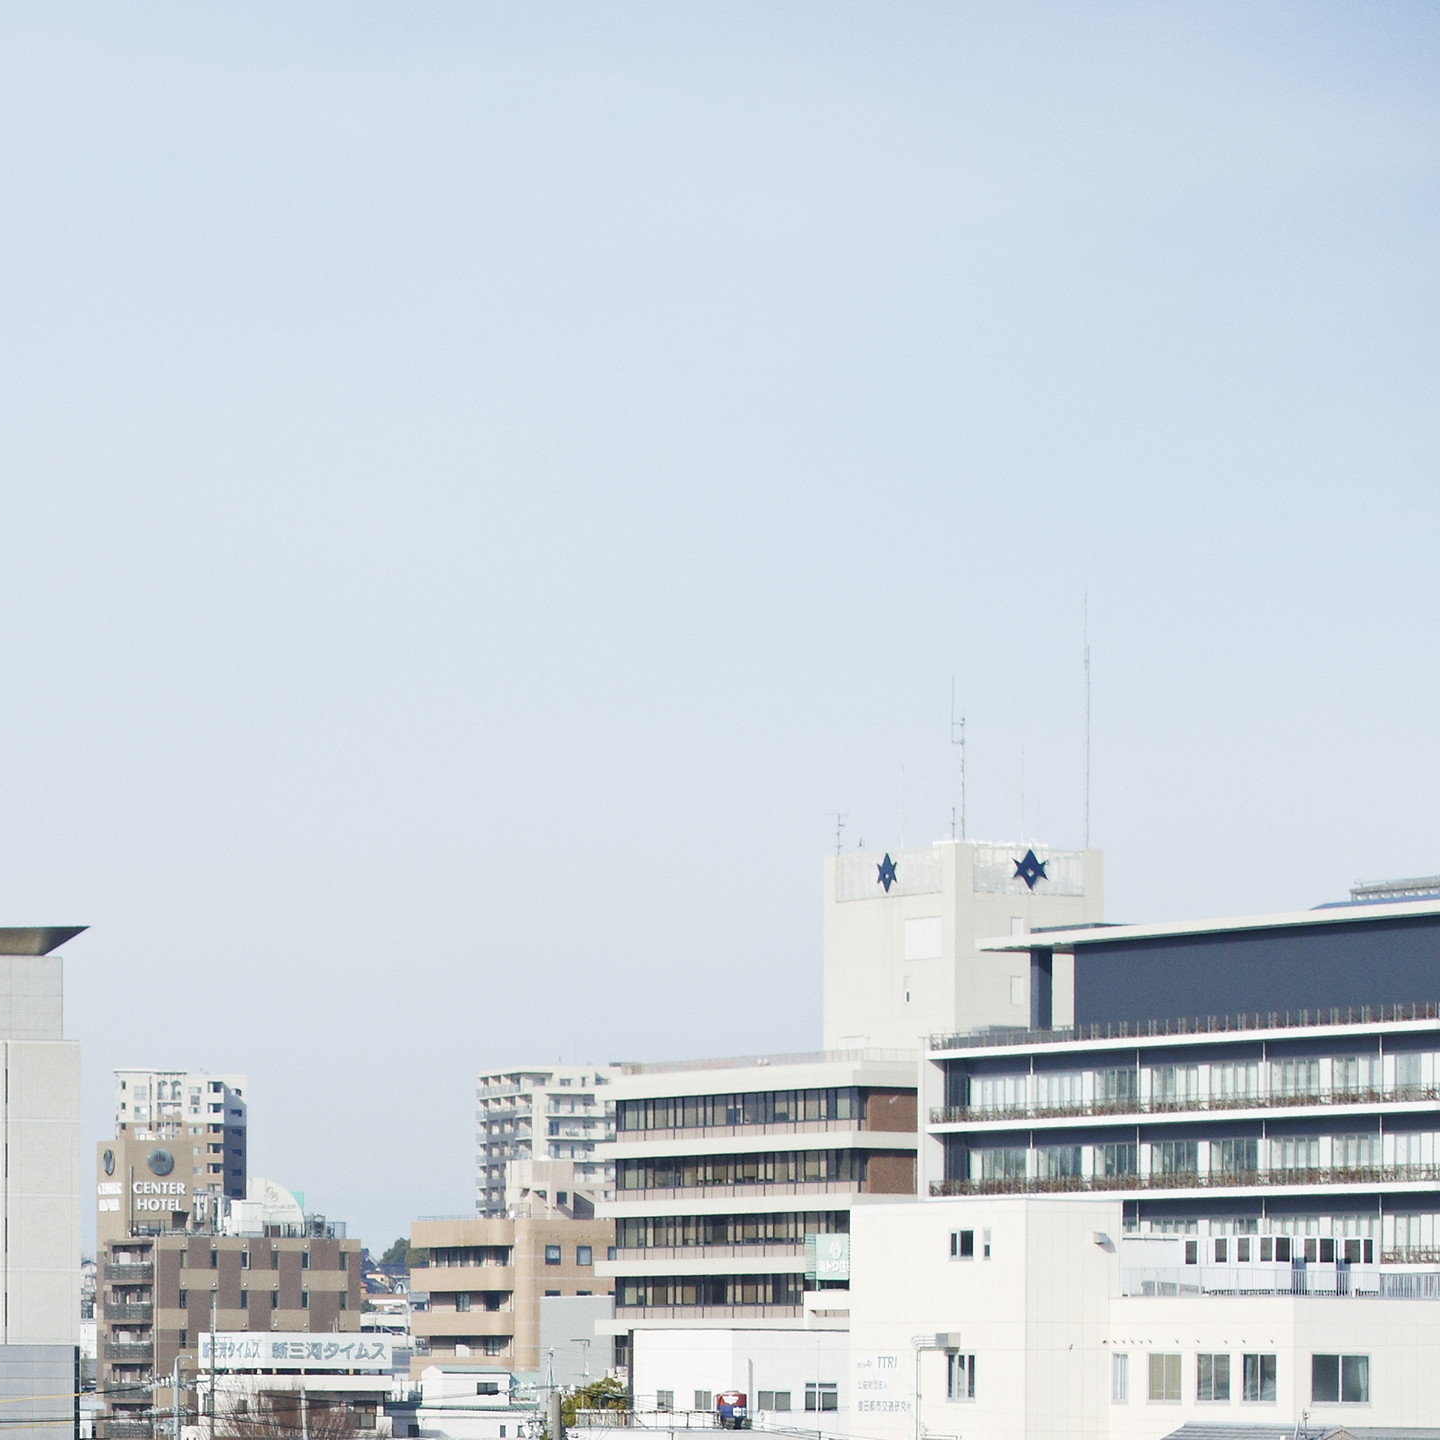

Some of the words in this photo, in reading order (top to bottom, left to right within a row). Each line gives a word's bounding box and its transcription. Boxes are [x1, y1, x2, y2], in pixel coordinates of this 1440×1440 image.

[133, 1182, 186, 1195] CENTER
[137, 1199, 183, 1212] HOTEL
[272, 1342, 387, 1361] 新三河タイムス
[877, 1356, 898, 1369] TTRI
